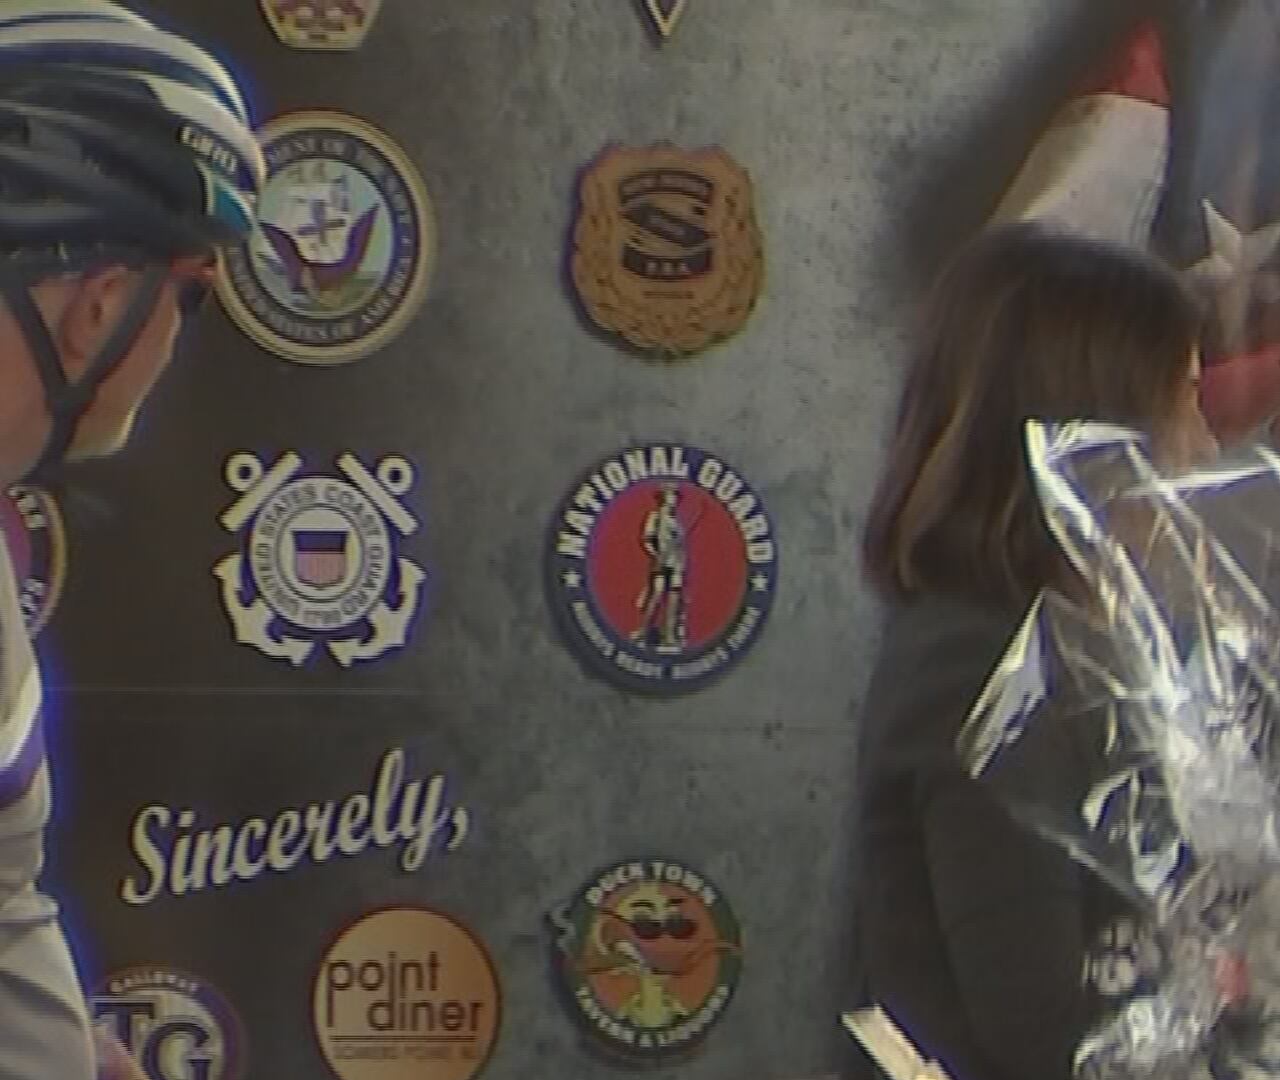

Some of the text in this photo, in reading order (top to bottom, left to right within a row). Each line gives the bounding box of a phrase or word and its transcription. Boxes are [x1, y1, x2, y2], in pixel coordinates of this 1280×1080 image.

[325, 485, 380, 537] COAST
[556, 447, 774, 563] NATIONAL GUARD
[120, 746, 469, 905] Sincerely,
[586, 860, 717, 905] DUCK TOWN
[327, 952, 440, 1020] point
[367, 988, 483, 1031] diner
